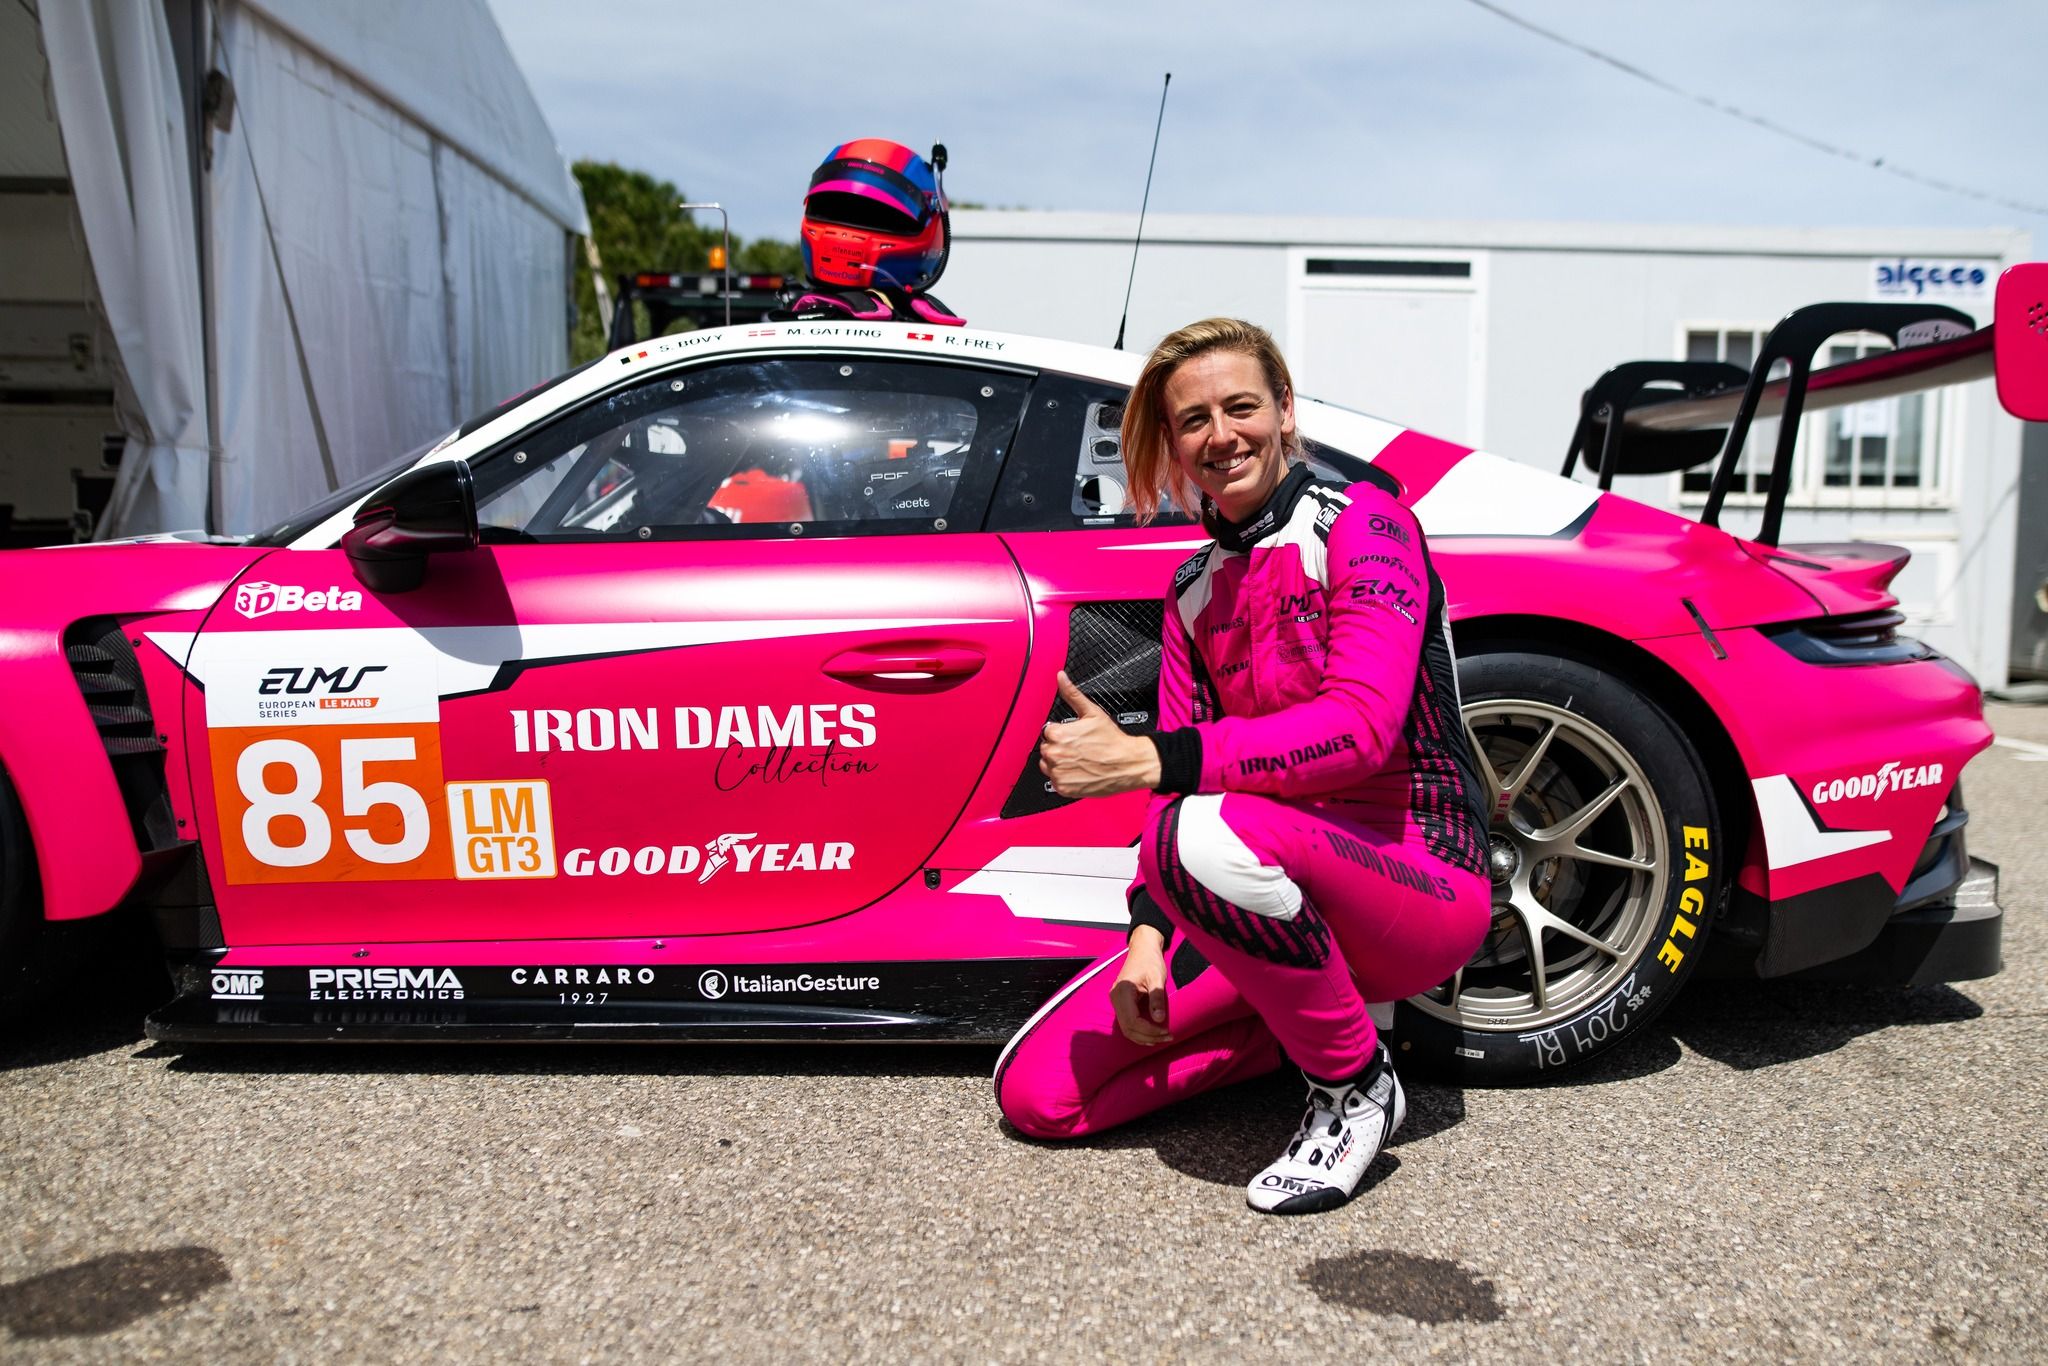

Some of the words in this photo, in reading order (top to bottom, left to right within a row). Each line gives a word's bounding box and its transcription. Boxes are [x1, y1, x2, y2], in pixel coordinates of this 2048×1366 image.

[678, 334, 723, 348] BOVY
[786, 328, 806, 336] M.
[810, 328, 882, 338] GATTING
[945, 335, 963, 347] R.
[964, 339, 1006, 352] FREY
[1368, 517, 1411, 542] OMP
[1348, 554, 1420, 587] GOODYEAR
[258, 665, 389, 695] ELMS
[258, 700, 316, 709] EUROPEAN
[323, 699, 339, 709] LE
[340, 698, 373, 708] MANS
[259, 710, 298, 718] SERIES
[509, 707, 660, 753] IRON
[675, 703, 877, 749] DAMES
[714, 739, 880, 792] Collection
[1239, 751, 1288, 777] IRON
[1291, 733, 1357, 770] DAMES
[1811, 763, 1944, 804] GOODYEAR
[235, 737, 431, 868] 85
[462, 787, 537, 835] LM
[466, 836, 542, 874] GT3
[562, 839, 856, 879] GOODYEAR
[1322, 829, 1385, 877] IRON
[1387, 854, 1457, 903] DAMES
[1656, 825, 1711, 974] EAGLE
[211, 975, 265, 995] OMP
[309, 968, 464, 989] PRISMA
[511, 968, 656, 985] CARRARO
[733, 974, 881, 993] ItalianGesture
[310, 990, 466, 1000] ELECTRONICS
[558, 992, 610, 1005] 1927
[1570, 997, 1628, 1053] 204
